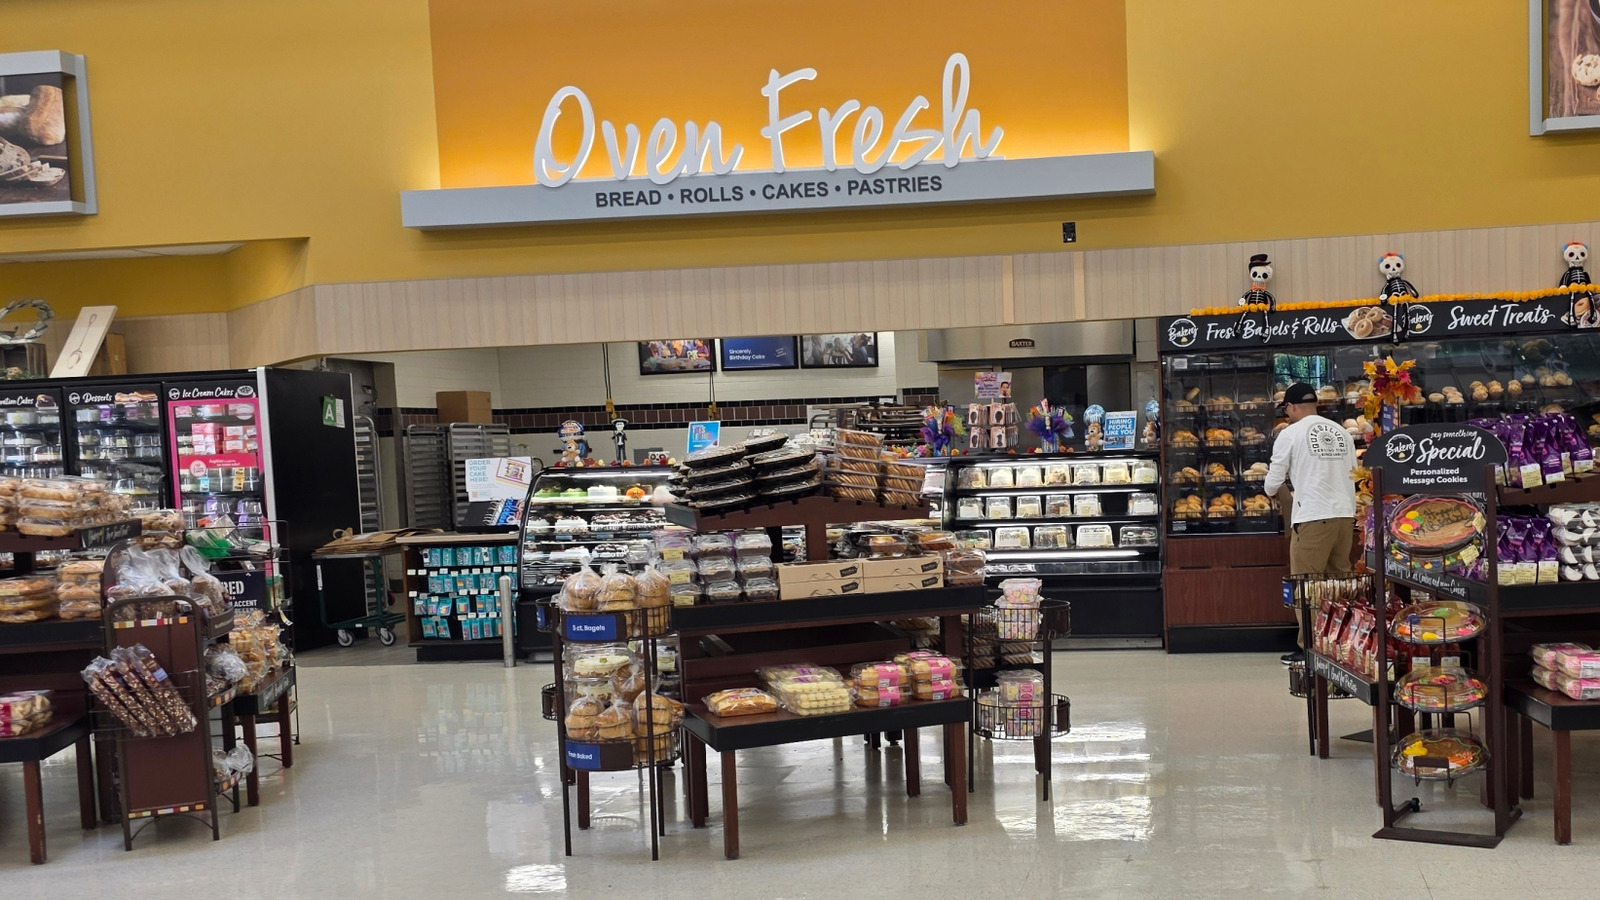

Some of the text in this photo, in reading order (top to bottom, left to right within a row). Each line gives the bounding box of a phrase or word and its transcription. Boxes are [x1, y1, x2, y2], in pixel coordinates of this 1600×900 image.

[533, 52, 1005, 188] Oven Fresh
[595, 175, 943, 208] BREAD ROLLS CAKES PASTRIES
[1448, 303, 1556, 330] Sweet Treats
[1168, 326, 1198, 342] Bakery
[1291, 318, 1301, 339] &
[1302, 316, 1343, 335] Rolls
[82, 392, 113, 403] Desserts
[182, 389, 192, 398] Ice
[192, 387, 214, 398] Cream
[215, 386, 234, 397] Cakes
[325, 404, 335, 421] A
[1443, 429, 1477, 440] something
[1385, 442, 1416, 457] Bakery
[1416, 436, 1486, 466] Special
[1410, 467, 1460, 475] Personalized
[1403, 477, 1435, 485] Message
[584, 625, 606, 633] Bagels
